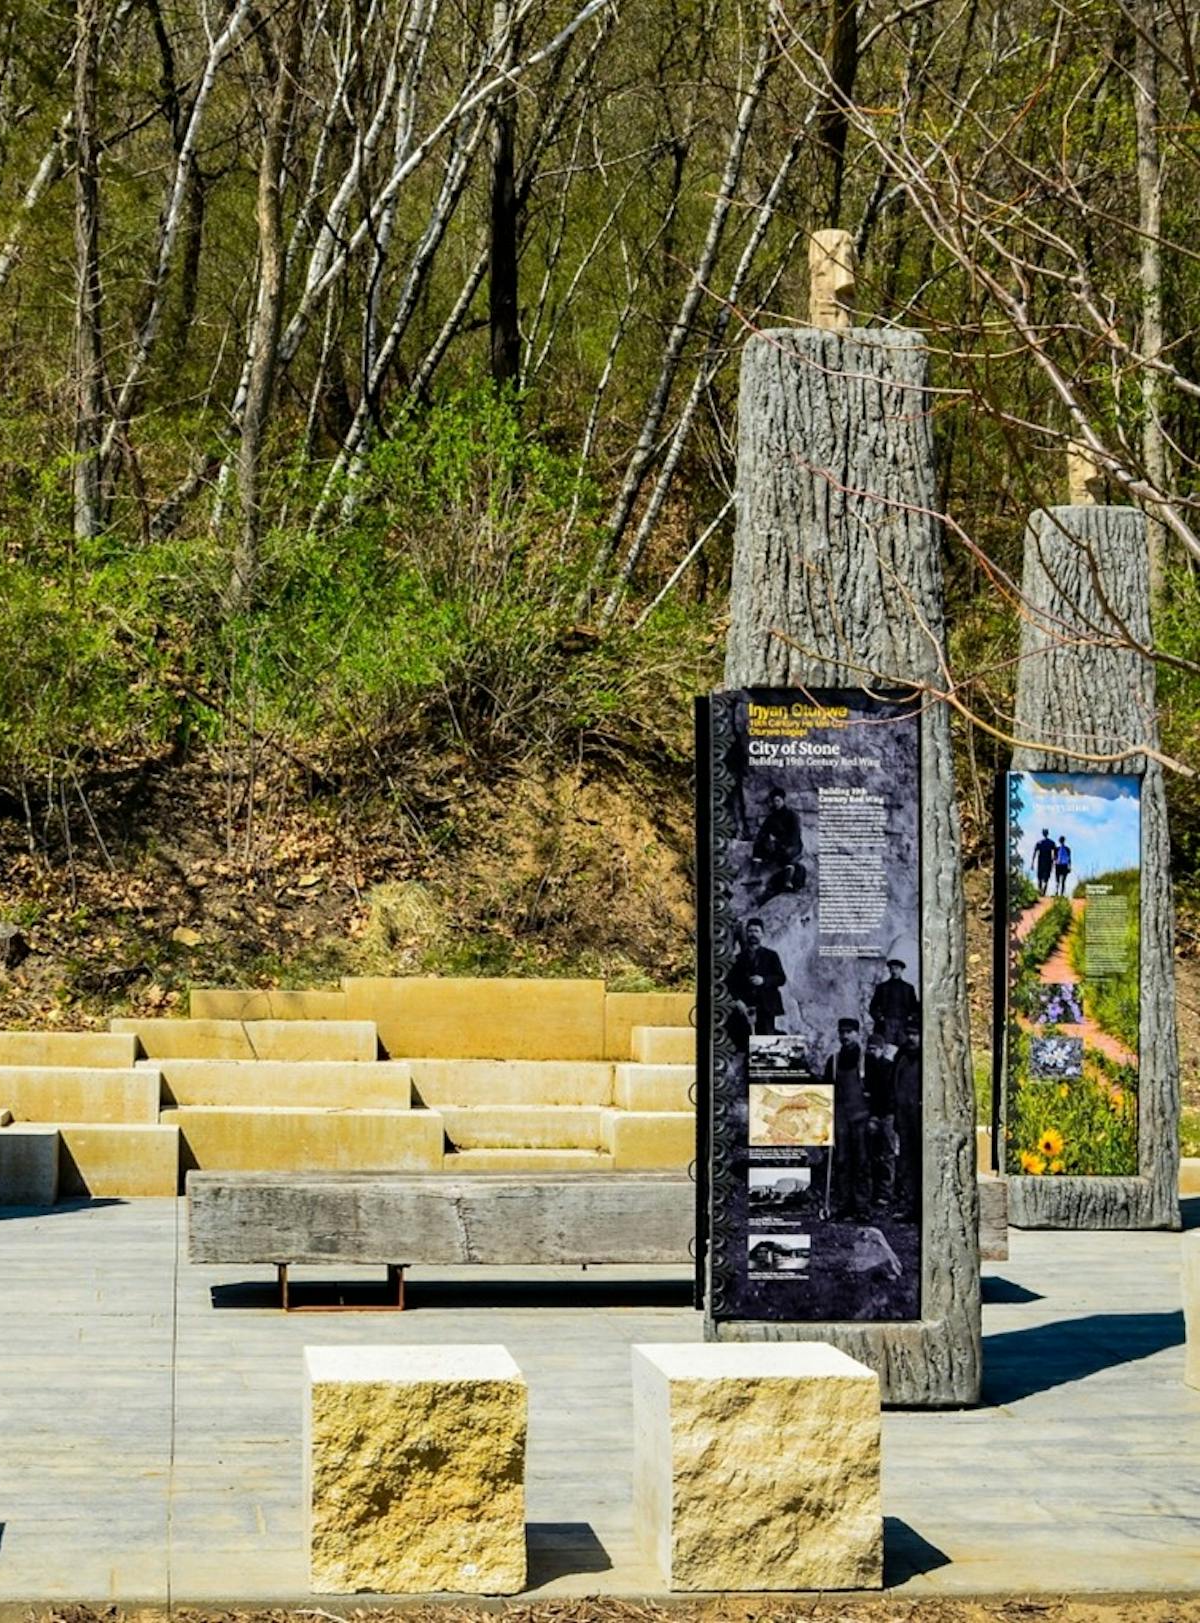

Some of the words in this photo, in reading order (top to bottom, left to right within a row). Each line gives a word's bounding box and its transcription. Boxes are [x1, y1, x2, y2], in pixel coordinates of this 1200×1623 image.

[748, 740, 779, 757] City
[780, 741, 798, 755] of
[799, 741, 840, 755] Stone
[748, 757, 784, 768] Building
[785, 757, 804, 767] 19th
[806, 757, 839, 768] Century
[841, 758, 858, 767] Red
[859, 758, 881, 768] Wing
